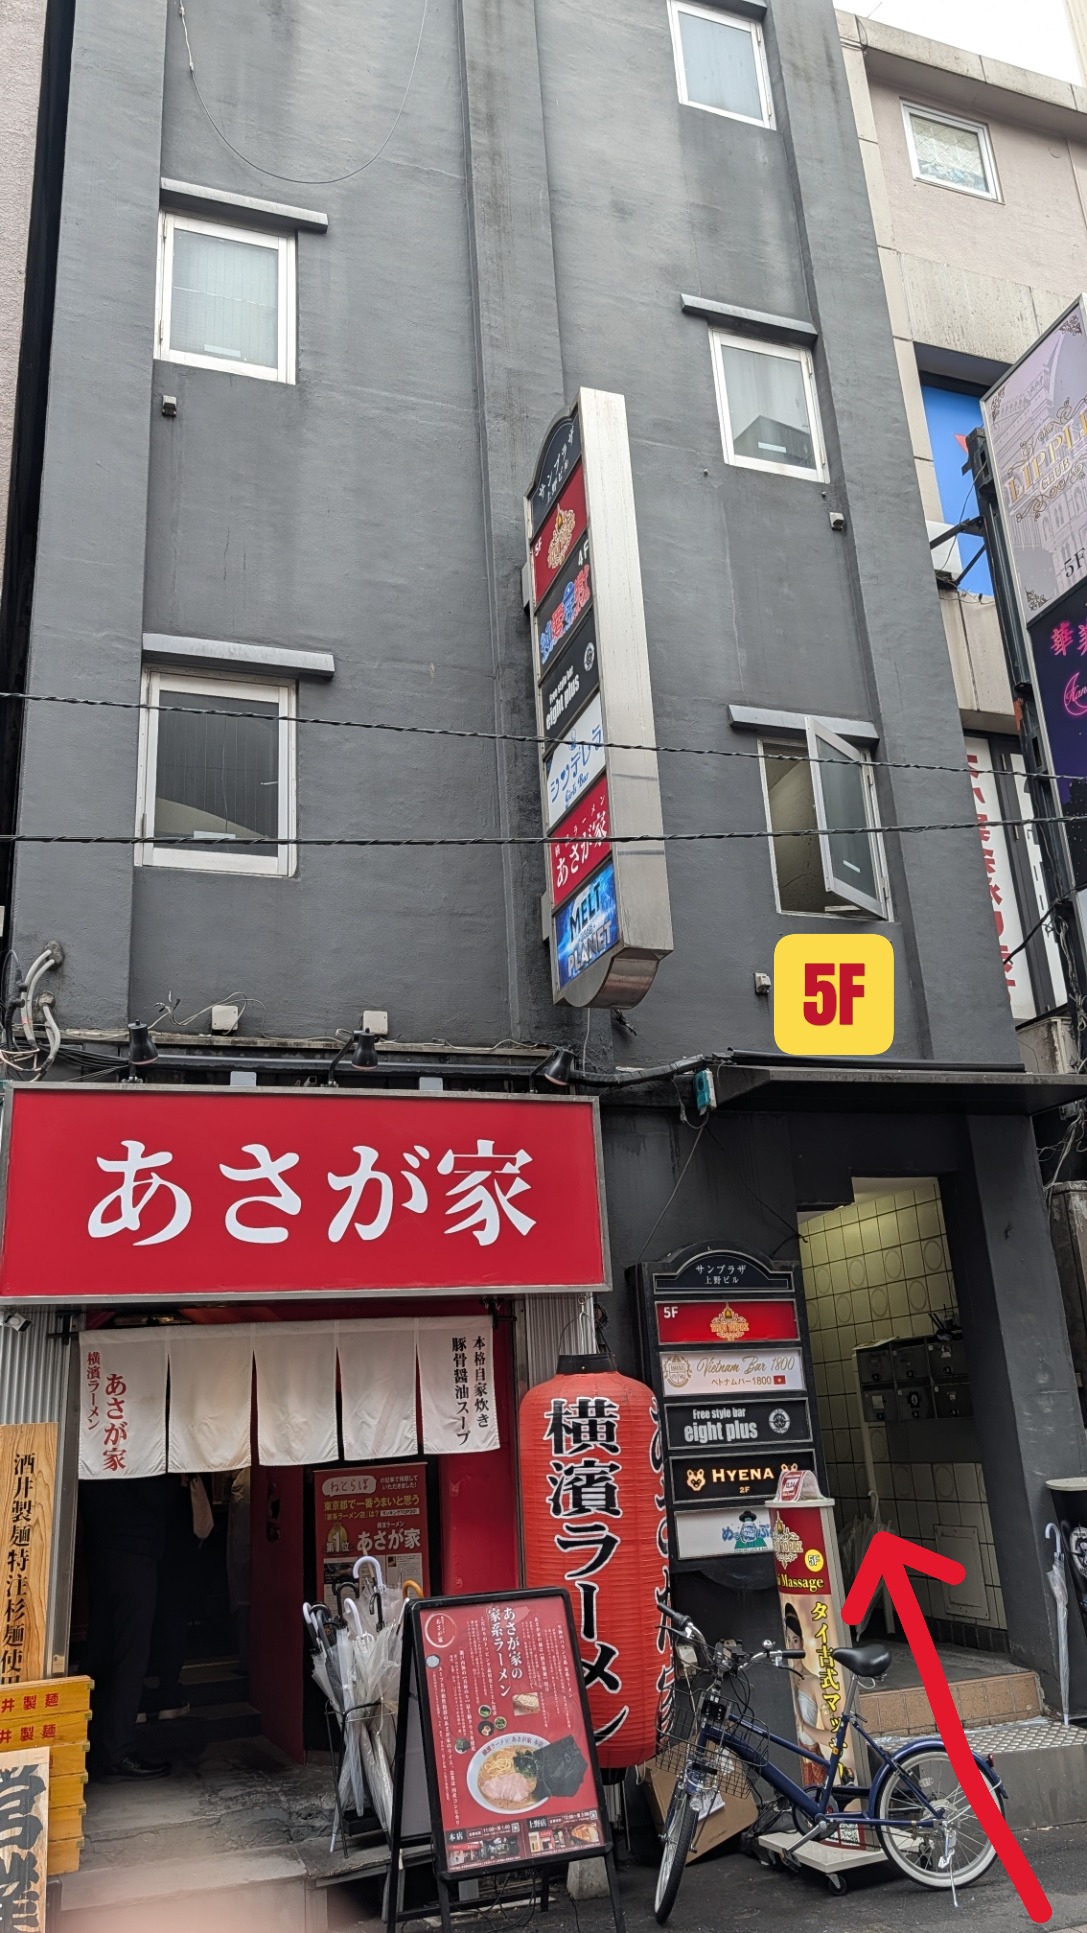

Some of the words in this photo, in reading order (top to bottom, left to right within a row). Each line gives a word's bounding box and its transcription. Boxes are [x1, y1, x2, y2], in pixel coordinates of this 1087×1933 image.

[578, 539, 590, 567] 4F
[1063, 547, 1086, 578] 5F
[546, 693, 565, 731] eight
[564, 673, 581, 706] plus
[551, 724, 602, 803] シンデレラ
[557, 811, 608, 888] あさが家
[569, 882, 601, 944] MELT
[568, 920, 612, 977] PLANET
[87, 1139, 537, 1247] あさが家
[695, 1264, 747, 1276] サンプラザ
[704, 1275, 739, 1286] 上野ビル
[663, 1306, 679, 1319] 5F
[696, 1356, 740, 1377] Vietnam
[742, 1355, 767, 1375] Bar
[771, 1356, 796, 1372] 1800
[86, 1351, 101, 1431] 横濱ラーメン
[452, 1337, 471, 1446] 豚骨醤油スープ
[473, 1336, 490, 1428] 本格自家炊き
[711, 1374, 772, 1388] ベトナムバー1800
[103, 1373, 128, 1471] あさが家
[692, 1408, 712, 1420] Free
[711, 1408, 732, 1420] style
[732, 1407, 746, 1418] bar
[684, 1421, 724, 1444] eight
[725, 1419, 758, 1442] plus
[330, 1478, 369, 1492] ねとらぼ
[712, 1467, 775, 1483] HYENA
[739, 1486, 751, 1494] 2F
[357, 1528, 420, 1551] あさが家
[543, 1398, 630, 1747] 横濱ラーメン
[807, 1554, 821, 1567] 5F
[781, 1574, 824, 1592] Massage
[488, 1608, 511, 1697] 家系ラーメン
[504, 1607, 522, 1679] あさが家の
